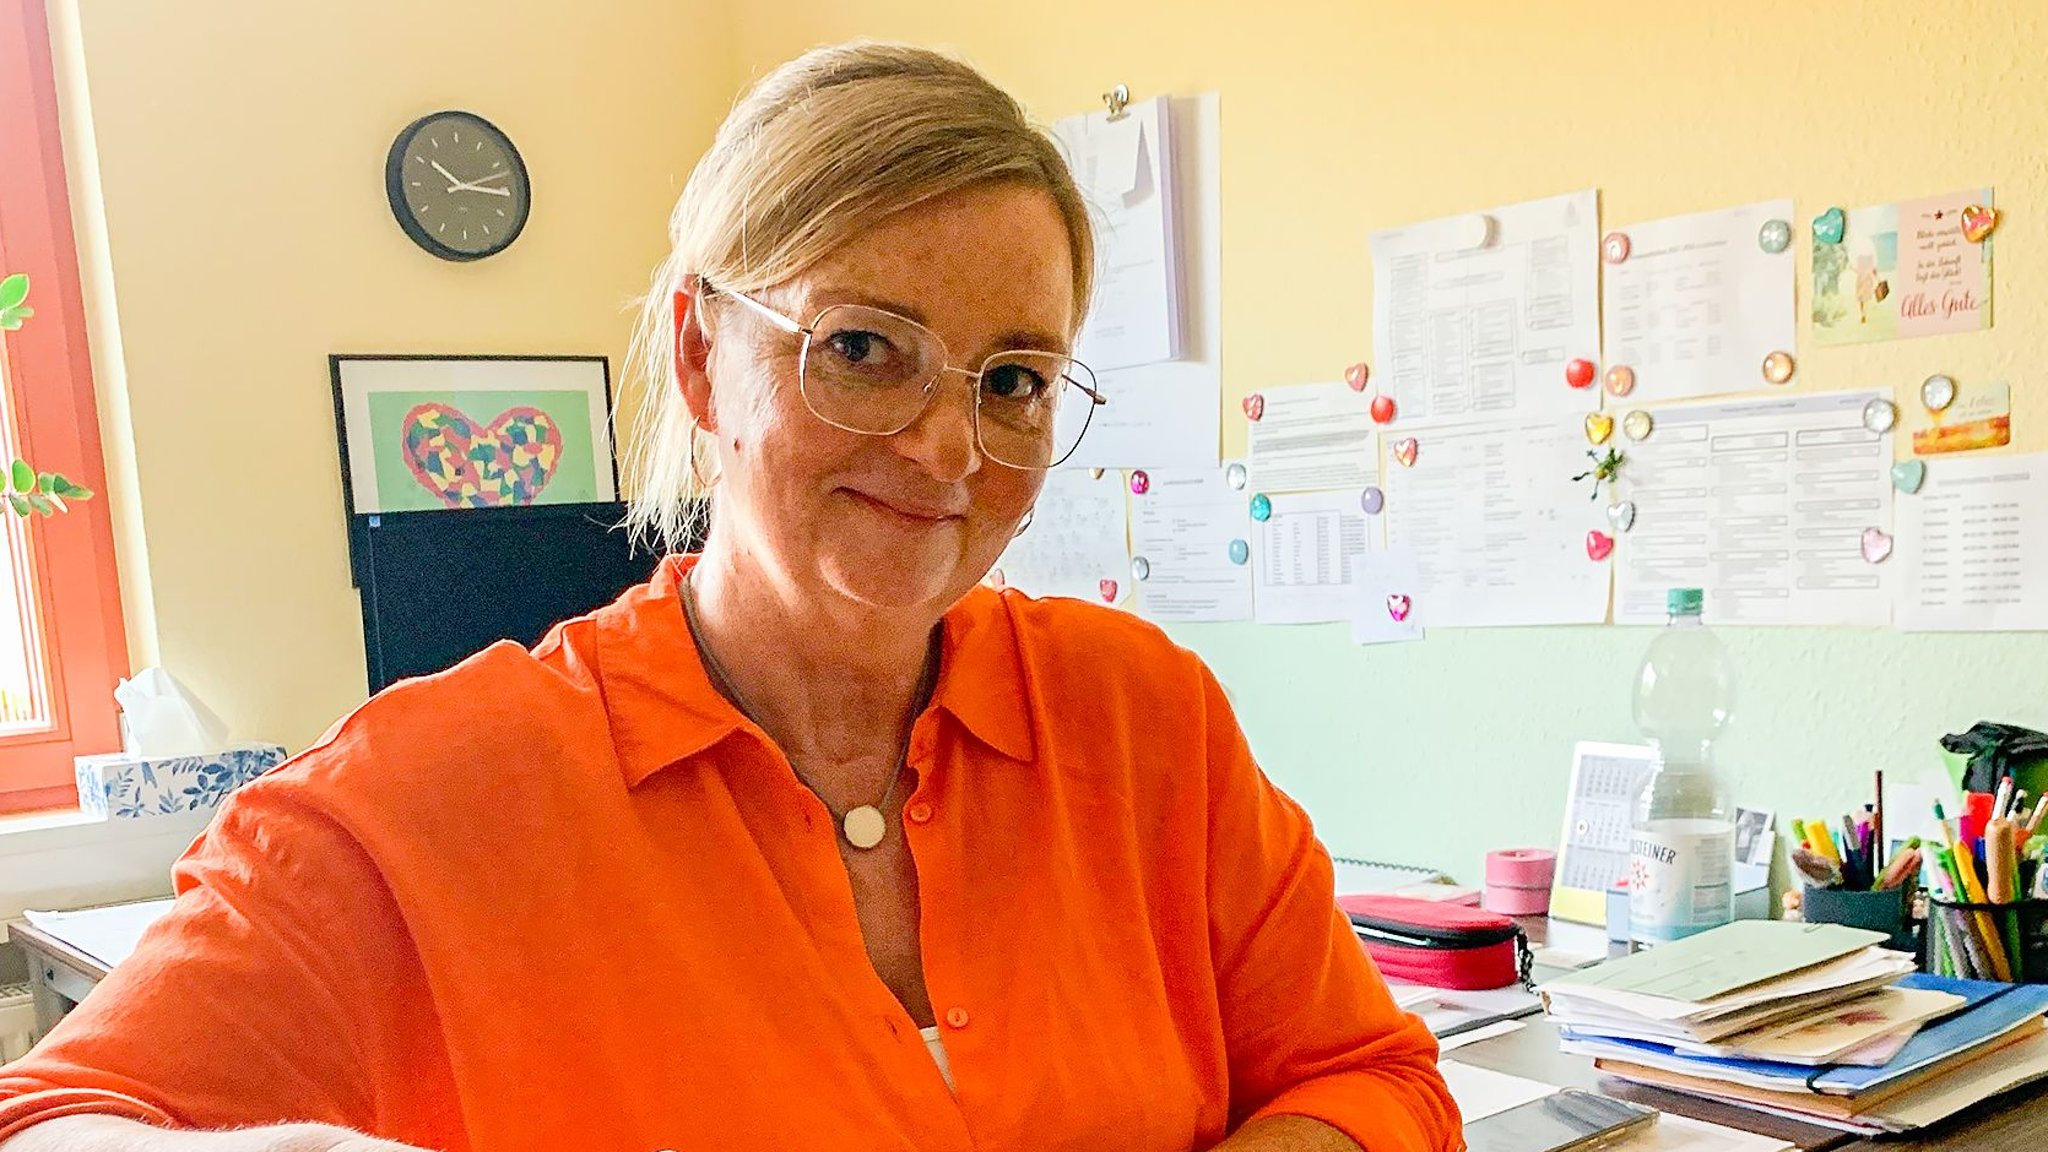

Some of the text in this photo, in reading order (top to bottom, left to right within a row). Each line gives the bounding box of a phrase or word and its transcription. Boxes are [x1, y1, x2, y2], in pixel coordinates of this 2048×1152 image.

[1901, 289, 1978, 320] Alles Gute
[1631, 838, 1676, 865] STEINER
